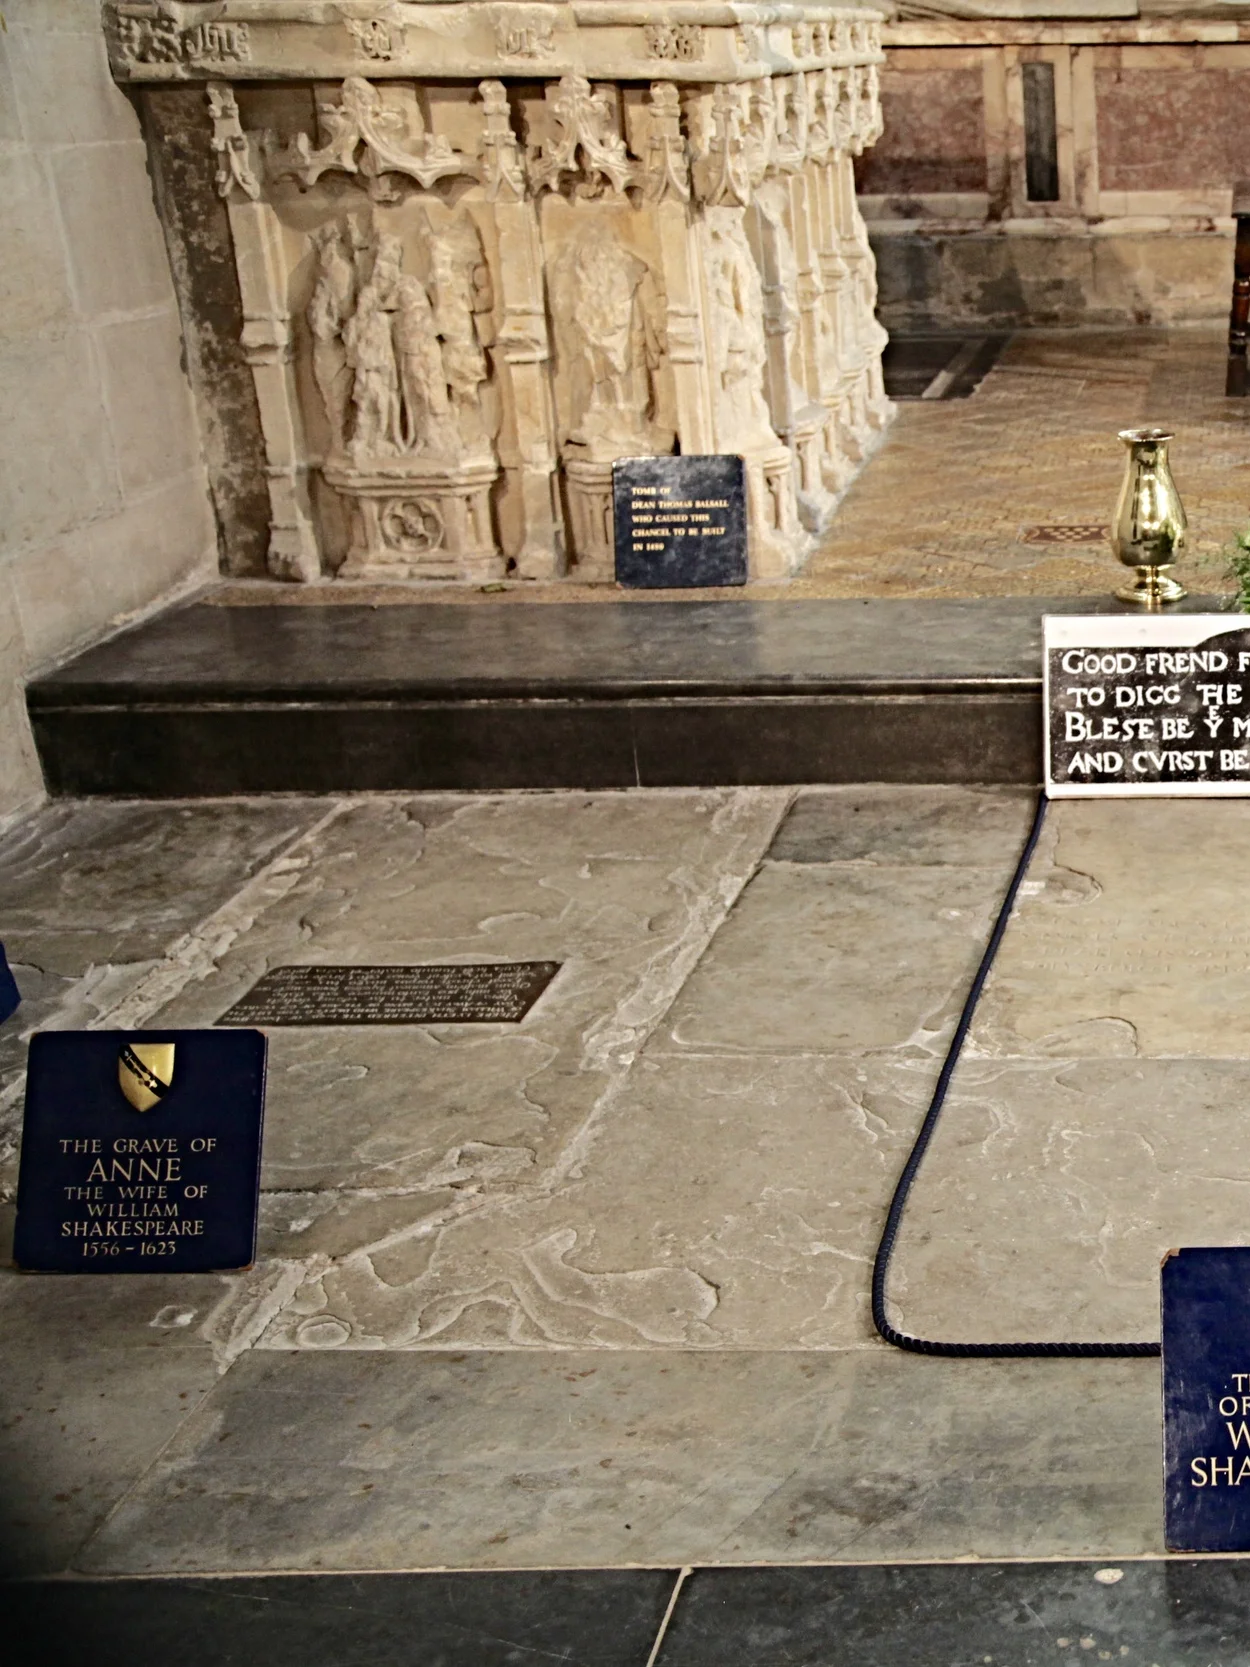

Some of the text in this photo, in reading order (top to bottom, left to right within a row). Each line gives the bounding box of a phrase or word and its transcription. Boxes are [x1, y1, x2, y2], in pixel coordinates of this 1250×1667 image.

[631, 486, 671, 495] TOMB OF
[631, 499, 729, 509] DEAN THOMAS BALSALL
[631, 513, 710, 523] WHO CAUSED THIS
[631, 527, 726, 537] CHANCEL TO BE BUILT
[632, 543, 643, 551] IN
[1061, 650, 1136, 675] GOOD
[1145, 650, 1228, 675] FREND
[1066, 686, 1105, 708] TO
[1196, 683, 1243, 706] THE
[1064, 711, 1155, 742] BLESE
[1162, 717, 1194, 741] BE
[1067, 751, 1124, 774] AND
[1132, 750, 1214, 771] CVRST
[1220, 749, 1250, 771] BE
[59, 1137, 217, 1154] THE GRAVE OF
[86, 1157, 182, 1182] ANNE
[64, 1185, 208, 1200] THE WIFE OF
[87, 1202, 179, 1217] WILLIAM
[61, 1220, 204, 1237] SHAKESPEARE
